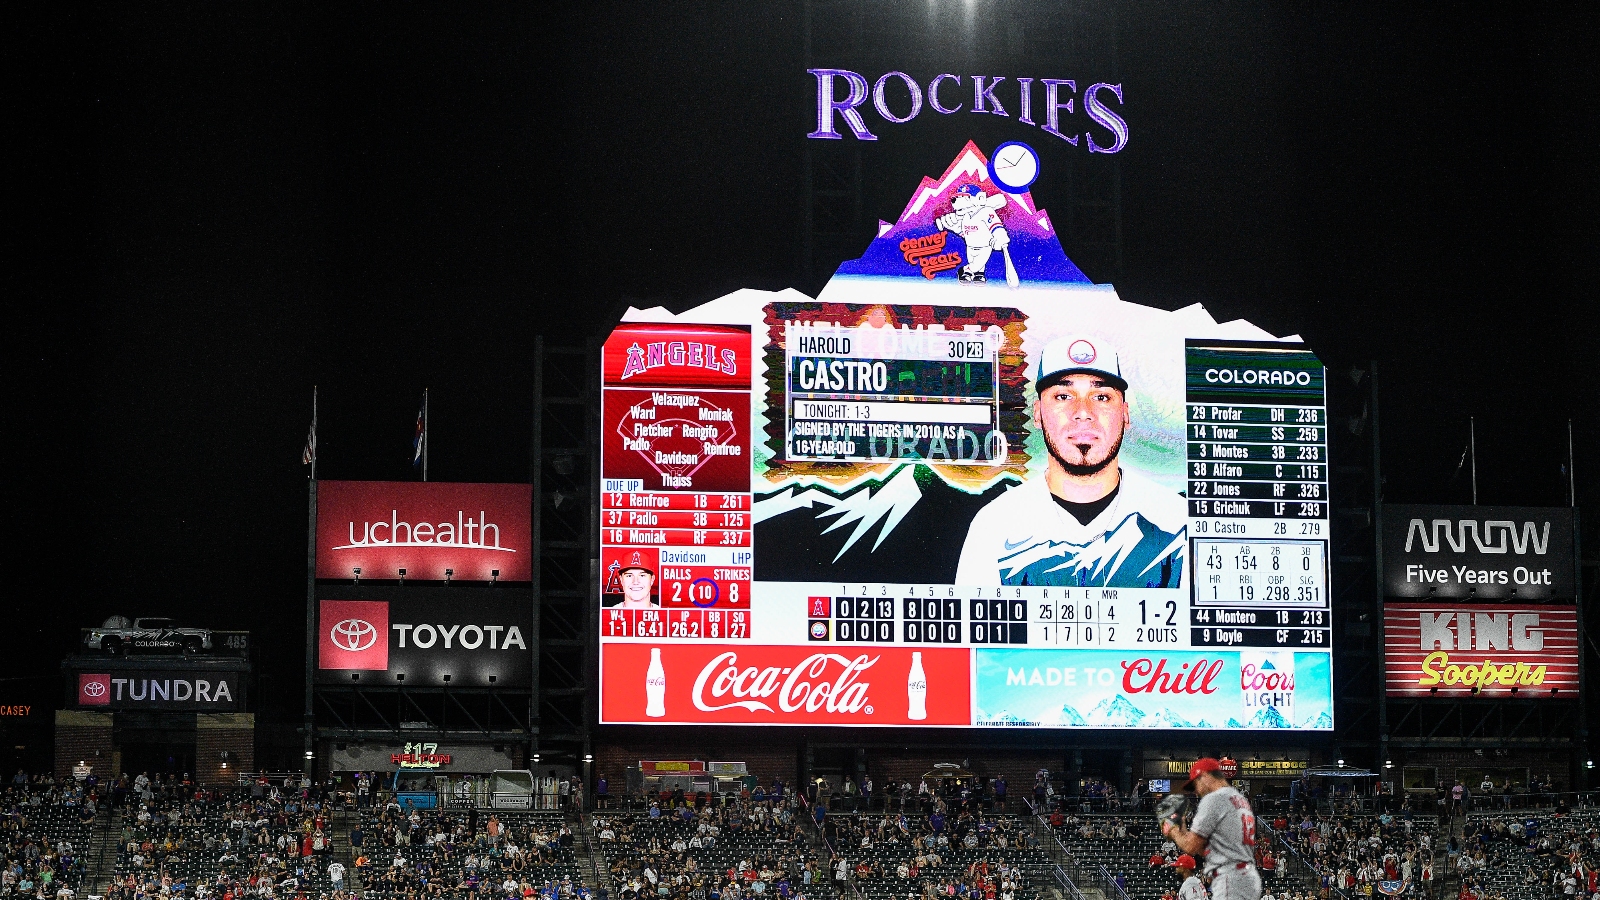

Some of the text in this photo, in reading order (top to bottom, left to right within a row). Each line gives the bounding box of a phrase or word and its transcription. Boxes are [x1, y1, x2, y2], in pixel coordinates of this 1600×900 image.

[807, 68, 1129, 154] ROCKIES
[900, 231, 948, 258] denver
[919, 252, 962, 272] bears
[800, 336, 982, 358] HAROLD 30 2B
[620, 342, 736, 380] ANGELS
[799, 360, 887, 392] CASTRO
[1205, 369, 1310, 386] COLORADO
[652, 392, 700, 408] Velazquez
[630, 406, 733, 421] Ward Moniak
[804, 404, 870, 419] TONIGHT: 1-3
[1193, 406, 1318, 422] 29 Profar DH .236
[634, 423, 718, 440] Fletcher Rengifo
[794, 422, 965, 439] SIGNED BY THE TIGERS IN 2010 AS A
[1194, 425, 1318, 441] 14 Tovar SS .259
[624, 437, 741, 455] Padlo Renfroe
[795, 440, 855, 455] 16-YEAR-OLD
[1200, 444, 1318, 460] 3 Montes 3B .233
[656, 451, 698, 464] Davidson
[1194, 463, 1319, 479] 38 Alfaro C .115
[606, 480, 639, 492] DUE UP
[661, 473, 692, 487] Thaiss
[1194, 482, 1319, 497] 22 Jones RF .326
[610, 493, 742, 508] 12 Renfroe 1B .261
[1195, 501, 1320, 516] 15 Grichuk LF .293
[609, 511, 743, 526] 37 Padlo 3B .125
[350, 510, 500, 547] uchealth
[1195, 521, 1320, 535] 30 Castro 2B .279
[1405, 518, 1550, 554] ARROW
[610, 529, 742, 545] 16 Moniak RF .337
[662, 550, 750, 564] Davidson LHP
[1212, 546, 1310, 555] H AB 2B 3B
[1207, 555, 1310, 570] 43 154 8 0
[664, 569, 750, 580] BALLS STRIKES
[1210, 575, 1314, 585] HR RBI OBP SLG
[1406, 564, 1551, 585] Five Years Out
[672, 582, 739, 603] 2 10 8
[1044, 590, 1118, 600] R H E MVR
[1212, 585, 1319, 601] 1 19 .298 .351
[610, 610, 744, 622] W-L ERA IP BB SO
[1040, 604, 1115, 620] 25 28 0 4
[1196, 610, 1322, 624] 44 Montero 1B .213
[392, 624, 526, 650] TOYOTA
[609, 621, 746, 638] 1-1 6.41 26.2 8 27
[1044, 627, 1115, 642] 1 7 0 2
[1137, 628, 1178, 642] 2 OUTS
[1204, 629, 1323, 645] 9 Doyle CF .215
[1420, 612, 1544, 651] KING
[227, 635, 246, 649] 485
[1006, 658, 1224, 694] MADE TO Chill
[1419, 651, 1546, 695] Soopers
[112, 679, 232, 702] TUNDRA
[692, 652, 881, 714] Coca-Cola
[1246, 693, 1291, 706] LIGHT
[1, 706, 31, 716] CASEY
[391, 753, 450, 764] HELTON
